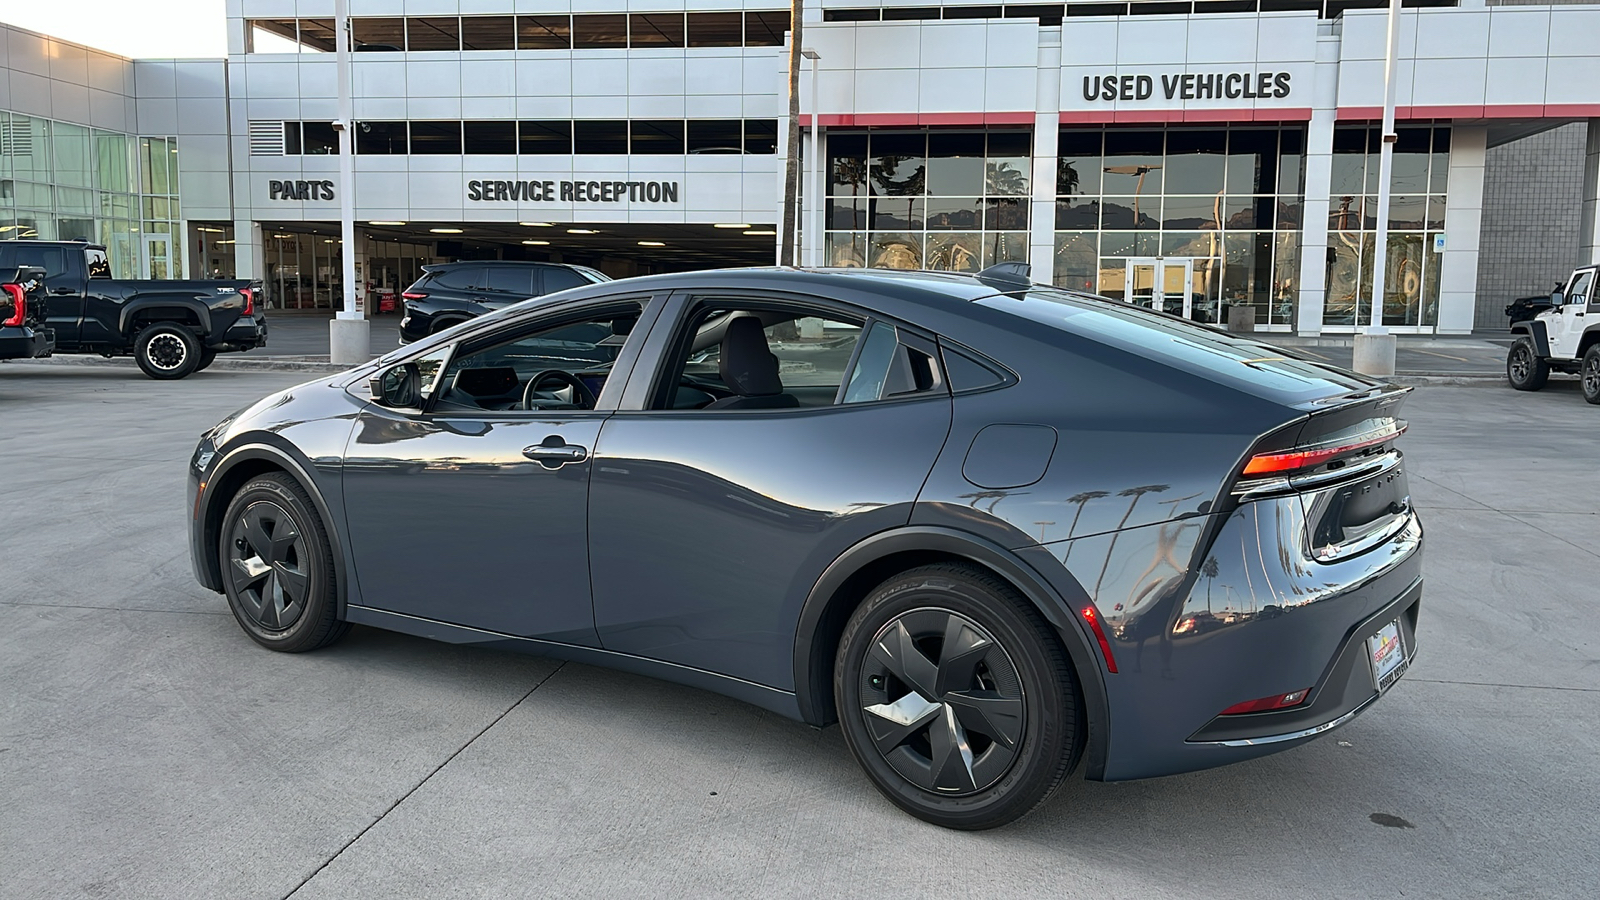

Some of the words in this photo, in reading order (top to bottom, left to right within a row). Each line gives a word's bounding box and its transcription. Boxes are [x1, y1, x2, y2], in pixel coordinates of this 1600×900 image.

[1083, 75, 1153, 101] USED
[1161, 72, 1291, 100] VEHICLES
[269, 180, 335, 200] PARTS
[468, 180, 555, 201] SERVICE
[560, 181, 678, 202] RECEPTION
